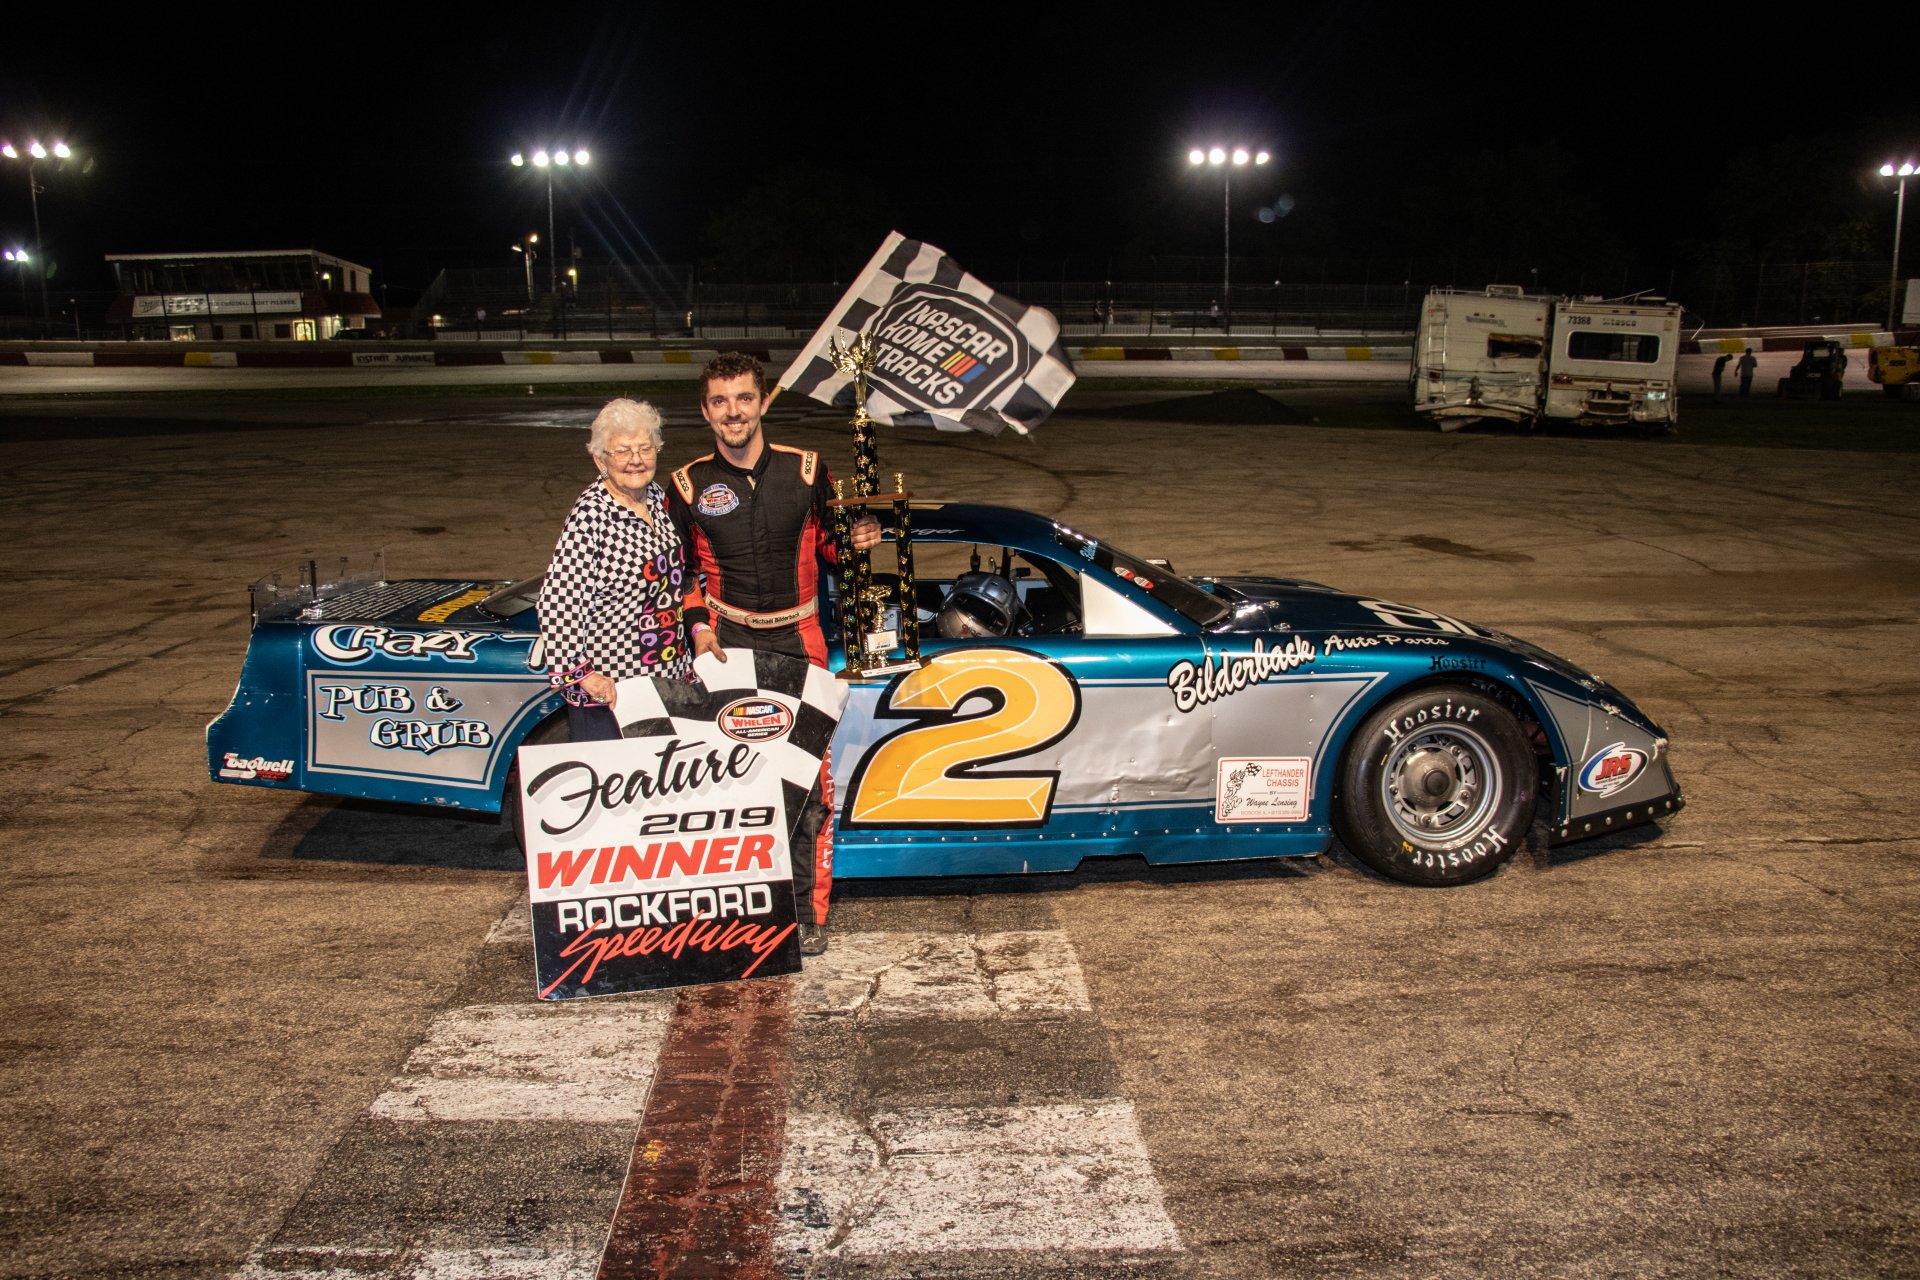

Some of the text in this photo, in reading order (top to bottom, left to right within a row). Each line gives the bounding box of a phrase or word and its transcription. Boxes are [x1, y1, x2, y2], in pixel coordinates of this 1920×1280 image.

[902, 302, 1008, 365] NASCAR
[1568, 316, 1591, 325] 73368
[878, 321, 954, 363] HOME
[877, 344, 963, 405] TRACKS
[1168, 634, 1450, 712] Bilderback Auto Parts
[1429, 655, 1487, 670] Hoosier
[320, 684, 464, 720] PUB &
[731, 714, 781, 727] WHELEN
[746, 705, 773, 715] NASCAR
[1384, 698, 1480, 747] Hoosier
[370, 718, 495, 755] GRUB
[840, 646, 1081, 829] 2
[526, 739, 760, 835] Feature
[1262, 769, 1304, 778] LEFTHANDER
[1266, 779, 1299, 787] CHASSIS
[639, 806, 776, 837] 2019
[1246, 797, 1269, 808] Wayne
[537, 834, 776, 889] WINNER
[1412, 826, 1508, 875] Hoosier
[558, 883, 773, 933] ROCKFORD
[540, 909, 797, 1000] Speedway
